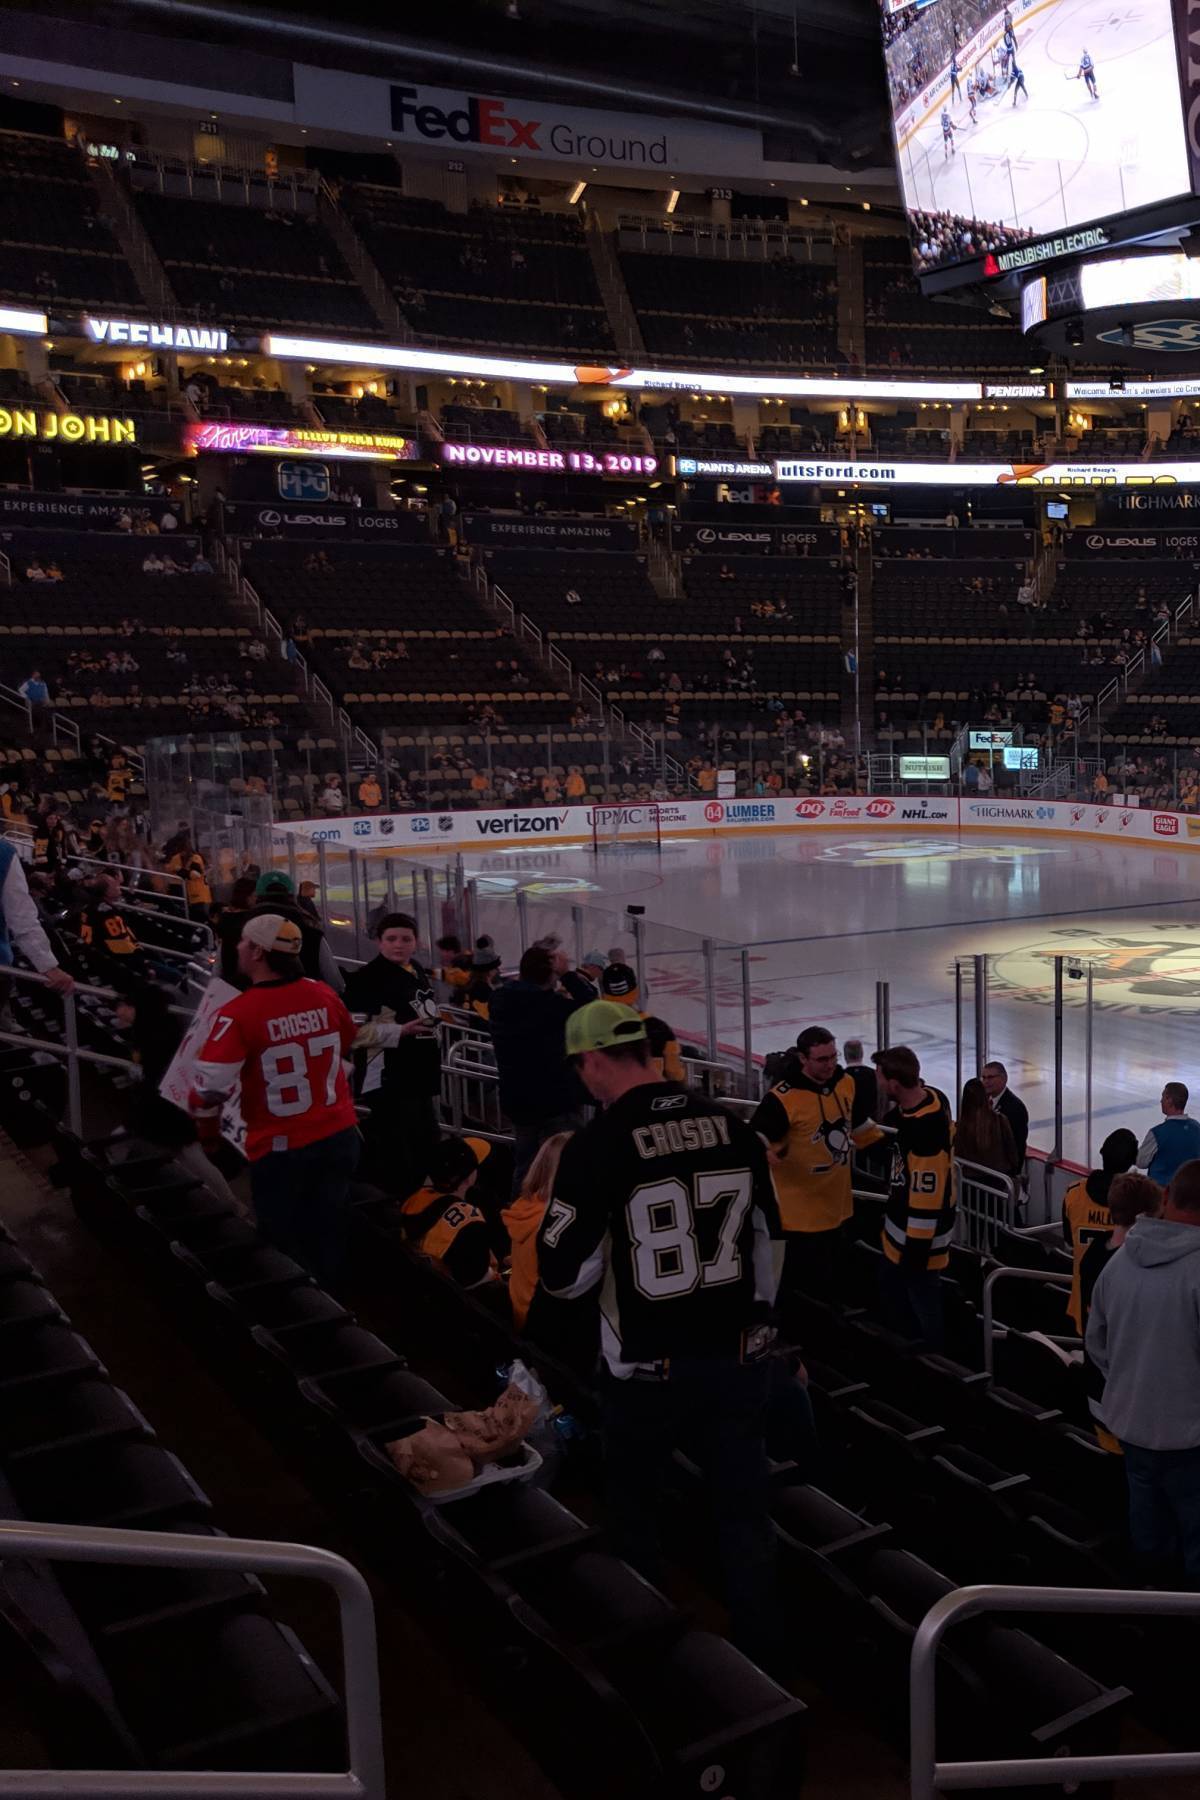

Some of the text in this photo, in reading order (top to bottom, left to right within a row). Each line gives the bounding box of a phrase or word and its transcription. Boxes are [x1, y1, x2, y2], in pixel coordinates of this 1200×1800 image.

[200, 122, 217, 134] 211
[389, 84, 668, 165] FedEx Ground
[448, 160, 465, 173] 212
[711, 188, 733, 200] 213
[997, 228, 1106, 271] MITSUBISHI ELECTRIC
[985, 385, 1046, 397] PENGUINS
[44, 412, 136, 443] JOHN
[449, 446, 565, 469] NOVEMBER
[607, 456, 658, 473] 2019
[698, 463, 735, 474] PAINTS
[736, 464, 772, 476] ARENA
[282, 464, 326, 496] PPG
[717, 483, 782, 507] FedEx
[3, 501, 84, 516] EXPERIENCE
[283, 513, 399, 529] LEXUS LOGES
[490, 522, 612, 538] EXPERIENCE AMAZING
[718, 532, 818, 544] LEXUS LOGES
[1106, 535, 1199, 547] LEXUS LOGES
[976, 733, 1005, 744] FedEx
[649, 807, 679, 815] SPORTS
[706, 805, 722, 819] 84
[726, 804, 775, 818] LUMBER
[800, 802, 822, 814] DQ
[869, 802, 892, 815] DQ
[901, 809, 948, 819] NHL.COM
[977, 806, 1034, 819] HIGHMARK
[476, 813, 560, 835] verizon
[586, 808, 642, 827] UPMC
[649, 814, 687, 823] MEDICINE
[1155, 817, 1176, 825] GIANT
[1155, 824, 1176, 833] EAGLE
[212, 1015, 234, 1042] 7
[265, 1007, 330, 1042] CROSBY
[260, 1031, 342, 1119] 87
[631, 1114, 732, 1160] CROSBY
[910, 1171, 937, 1194] 19
[543, 1196, 577, 1249] 7
[624, 1166, 753, 1302] 87
